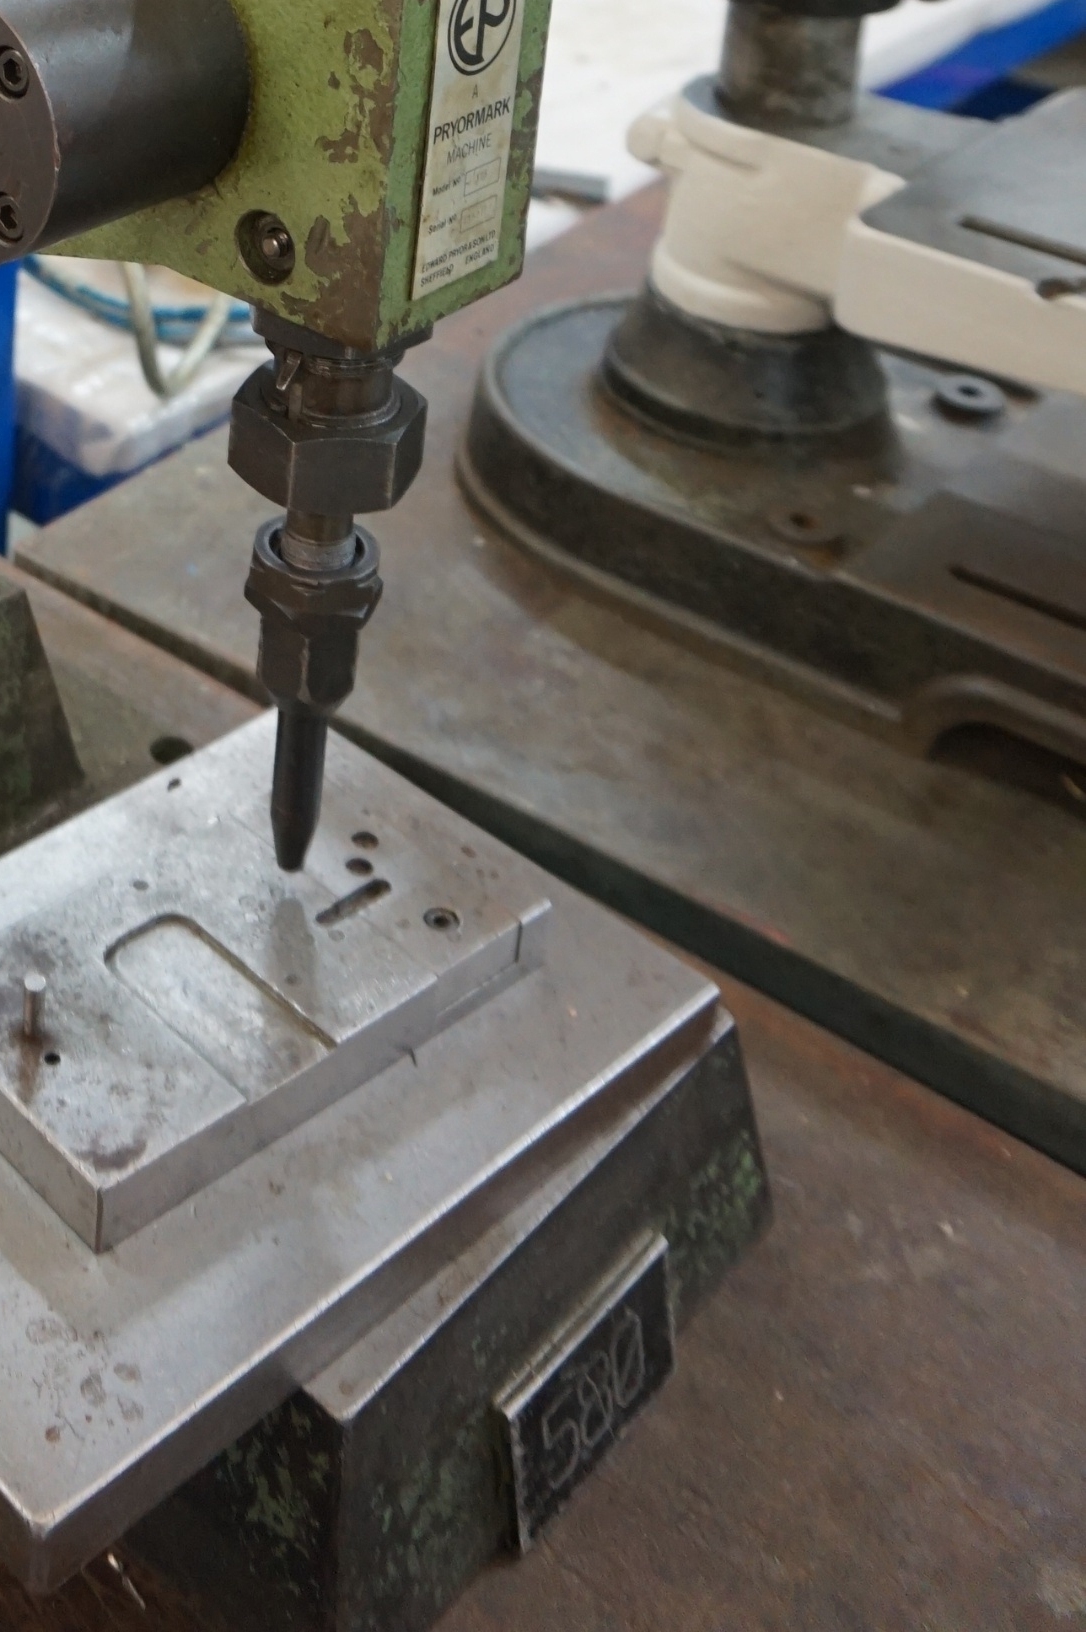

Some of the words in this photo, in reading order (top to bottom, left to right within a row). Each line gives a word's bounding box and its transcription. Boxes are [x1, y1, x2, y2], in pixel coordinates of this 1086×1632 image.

[471, 84, 479, 100] A
[433, 97, 511, 145] PRYORMARK
[446, 133, 493, 165] MACHINE
[432, 180, 451, 196] Model
[421, 253, 448, 274] EDWARD
